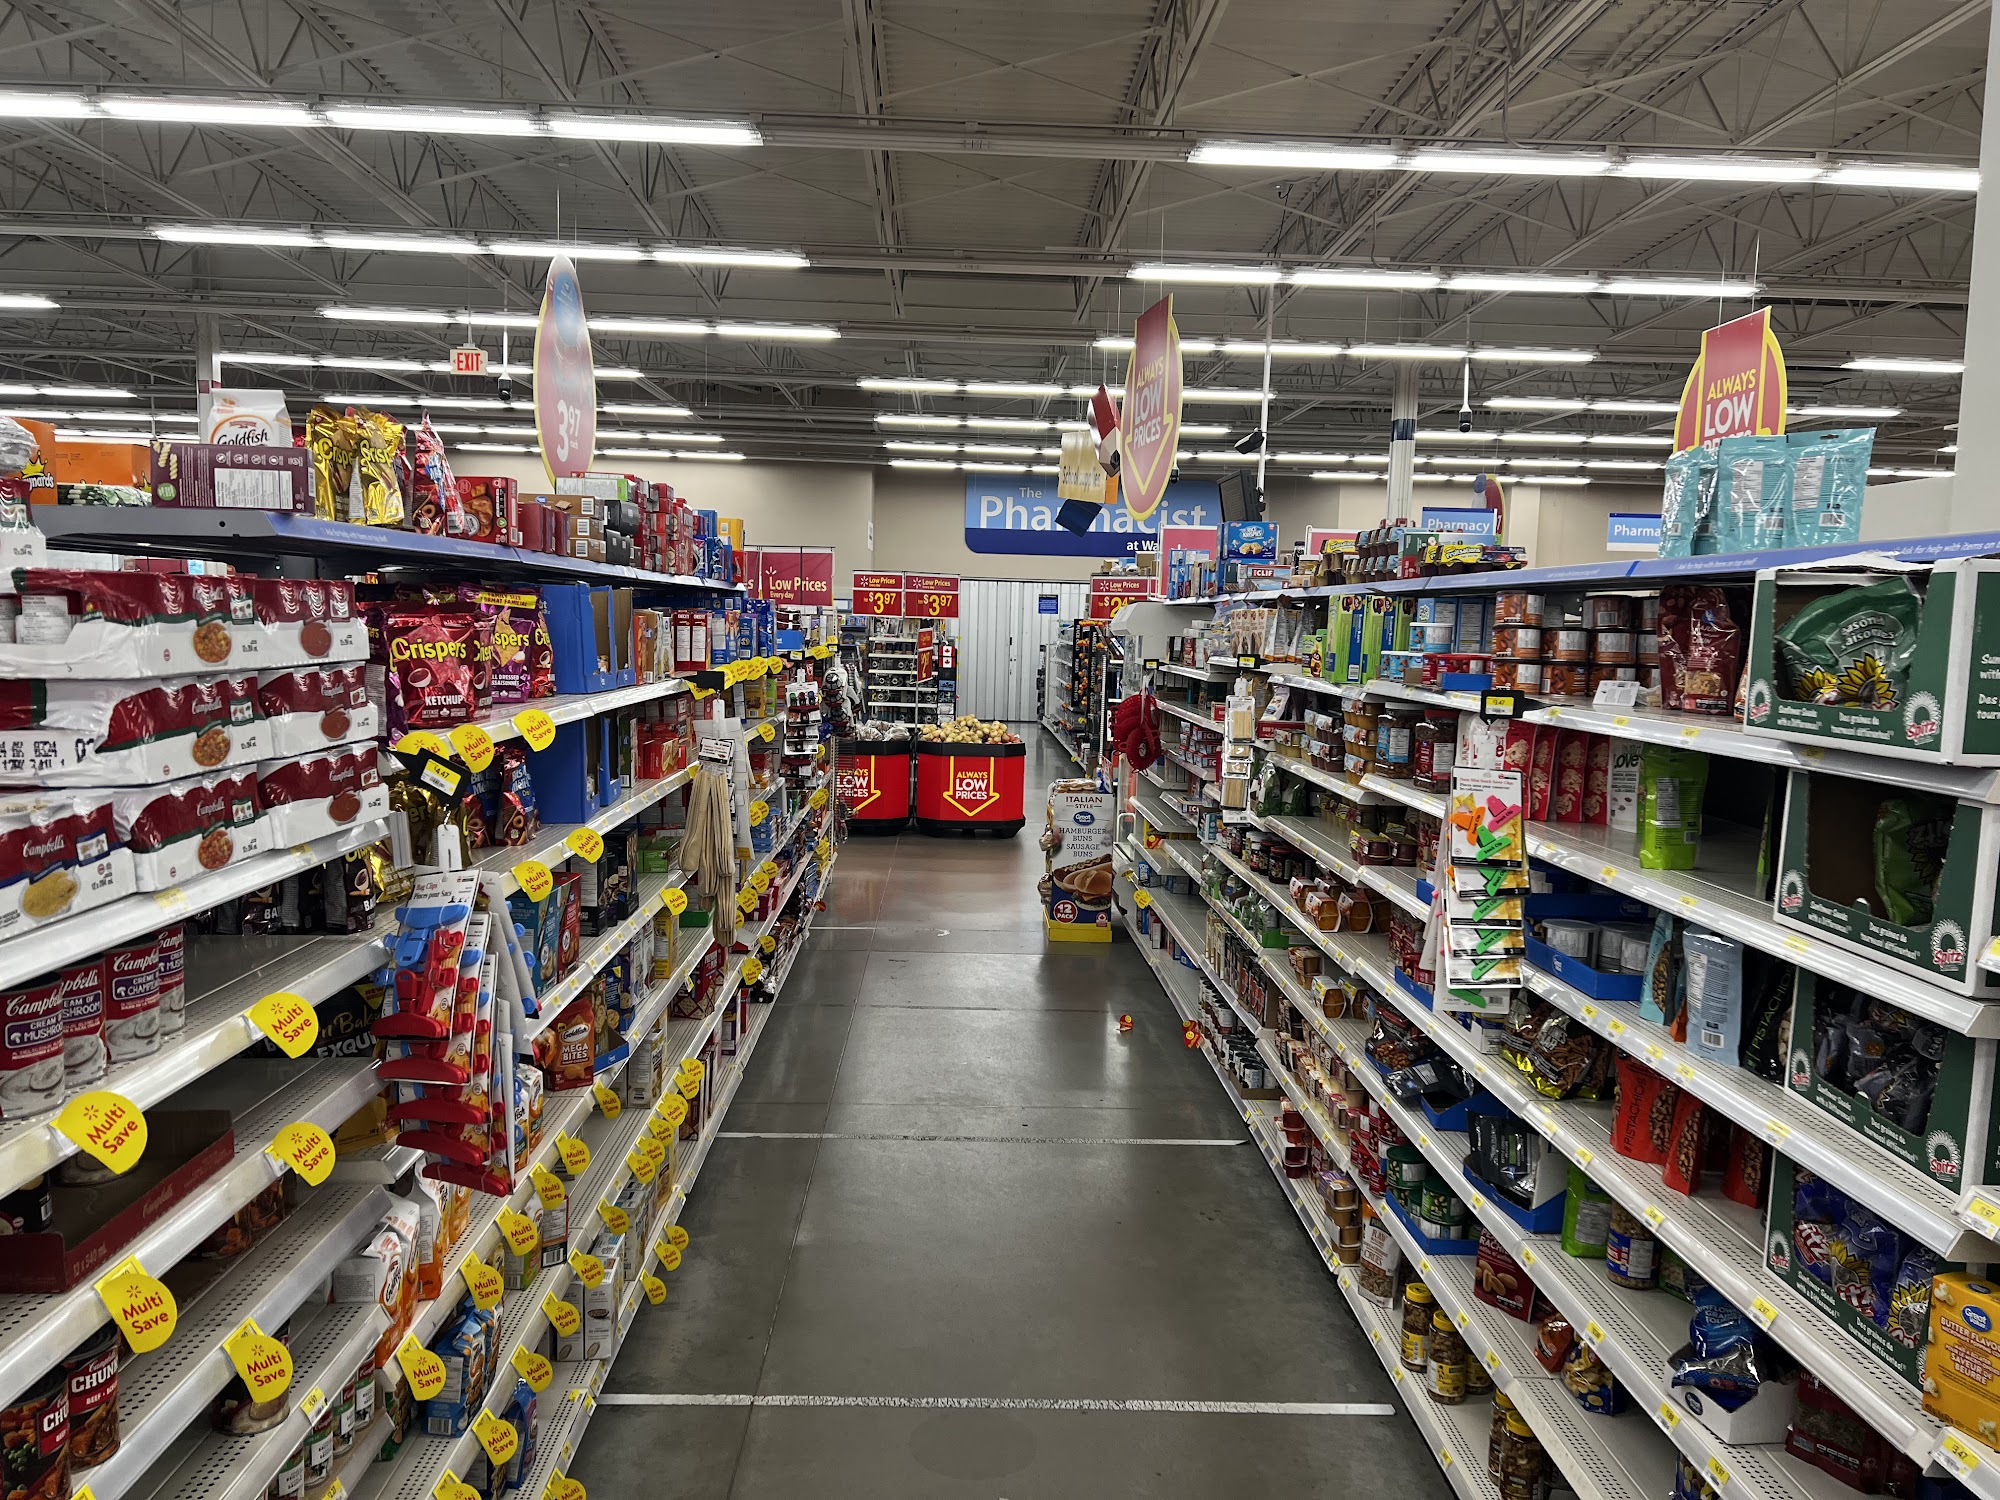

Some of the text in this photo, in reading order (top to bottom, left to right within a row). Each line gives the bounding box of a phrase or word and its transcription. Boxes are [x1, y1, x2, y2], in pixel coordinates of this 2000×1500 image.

[457, 352, 481, 371] EXIT
[1137, 357, 1164, 388] ALWAYS
[1707, 369, 1756, 401] ALWAYS
[1134, 379, 1163, 422] LOW
[1704, 391, 1755, 437] LOW
[217, 429, 269, 446] Goldfish
[1133, 418, 1161, 449] PRICES
[319, 438, 352, 469] Crisp
[1019, 487, 1042, 499] The
[979, 496, 1207, 534] Phaacist
[1427, 518, 1490, 532] Pharmacy
[1614, 524, 1661, 538] Pharma
[1126, 542, 1139, 551] at
[1901, 546, 1913, 554] Ask
[1914, 545, 1926, 554] for
[1926, 544, 1942, 555] help
[1944, 543, 1961, 552] with
[1961, 542, 1983, 551] items
[769, 576, 827, 592] Low Prices
[880, 577, 895, 585] Prices
[934, 579, 951, 587] Prices
[770, 591, 794, 600] Every day
[504, 599, 528, 607] FAMILIAL
[391, 637, 467, 663] Crispers
[425, 695, 463, 706] KETCHUP
[1979, 694, 1998, 704] Des
[526, 718, 548, 735] Multi
[1907, 721, 1937, 741] Spitz
[532, 728, 552, 742] Save
[464, 735, 487, 753] Multi
[470, 747, 491, 762] Save
[836, 776, 869, 789] LOW
[956, 771, 988, 780] ALWAYS
[955, 779, 988, 791] LOW
[836, 789, 869, 798] PRICES
[955, 791, 988, 800] PRICES
[22, 834, 65, 858] Campbell's
[577, 833, 596, 850] Multi
[585, 840, 602, 856] Save
[524, 868, 547, 887] Multi
[530, 880, 549, 893] Save
[669, 892, 684, 903] Multi
[672, 899, 686, 909] Save
[1057, 904, 1072, 914] 12
[1934, 949, 1963, 967] Spitz
[86, 996, 94, 1004] OF
[62, 1002, 100, 1018] SHROOM
[30, 1017, 56, 1030] CREAM
[271, 1003, 304, 1034] Multi
[283, 1018, 312, 1043] Save
[563, 1026, 588, 1040] Goldfish
[562, 1043, 588, 1053] MEGA
[563, 1051, 588, 1060] BITES
[683, 1079, 696, 1090] Multi
[685, 1084, 698, 1093] Save
[602, 1098, 617, 1107] Multi
[605, 1104, 619, 1112] Save
[666, 1106, 680, 1118] Multi
[670, 1112, 683, 1121] Save
[1625, 1078, 1646, 1147] PISTACHIOS
[86, 1104, 126, 1145] Multi
[102, 1118, 138, 1154] Save
[656, 1128, 670, 1137] Multi
[658, 1134, 672, 1143] Save
[292, 1133, 321, 1163] Multi
[566, 1149, 585, 1160] Multi
[303, 1146, 329, 1171] Save
[569, 1157, 587, 1167] Save
[634, 1161, 652, 1173] Multi
[637, 1168, 653, 1178] Save
[1930, 1158, 1957, 1176] Spitz
[541, 1181, 561, 1194] Multi
[542, 1190, 562, 1202] Save
[607, 1213, 624, 1226] Multi
[611, 1221, 627, 1231] Save
[510, 1223, 532, 1239] Multi
[515, 1234, 534, 1247] Save
[581, 1263, 599, 1276] Multi
[585, 1271, 601, 1281] Save
[474, 1277, 498, 1292] Multi
[478, 1288, 499, 1301] Save
[122, 1292, 164, 1321] Multi
[554, 1311, 575, 1326] Multi
[1964, 1307, 1987, 1324] Great
[131, 1311, 169, 1335] Save
[558, 1319, 577, 1330] Save
[1941, 1316, 1970, 1337] BUTTER
[247, 1352, 282, 1375] Multi
[1951, 1353, 1982, 1374] SAVEUR
[71, 1359, 118, 1394] CHUN
[254, 1366, 286, 1388] Save
[412, 1362, 440, 1380] Multi
[526, 1364, 547, 1378] Multi
[532, 1371, 550, 1384] Save
[1955, 1363, 1987, 1385] BEURRE
[418, 1375, 442, 1389] Save
[43, 1400, 69, 1432] CHU
[487, 1428, 511, 1446] Multi
[492, 1440, 514, 1455] Save
